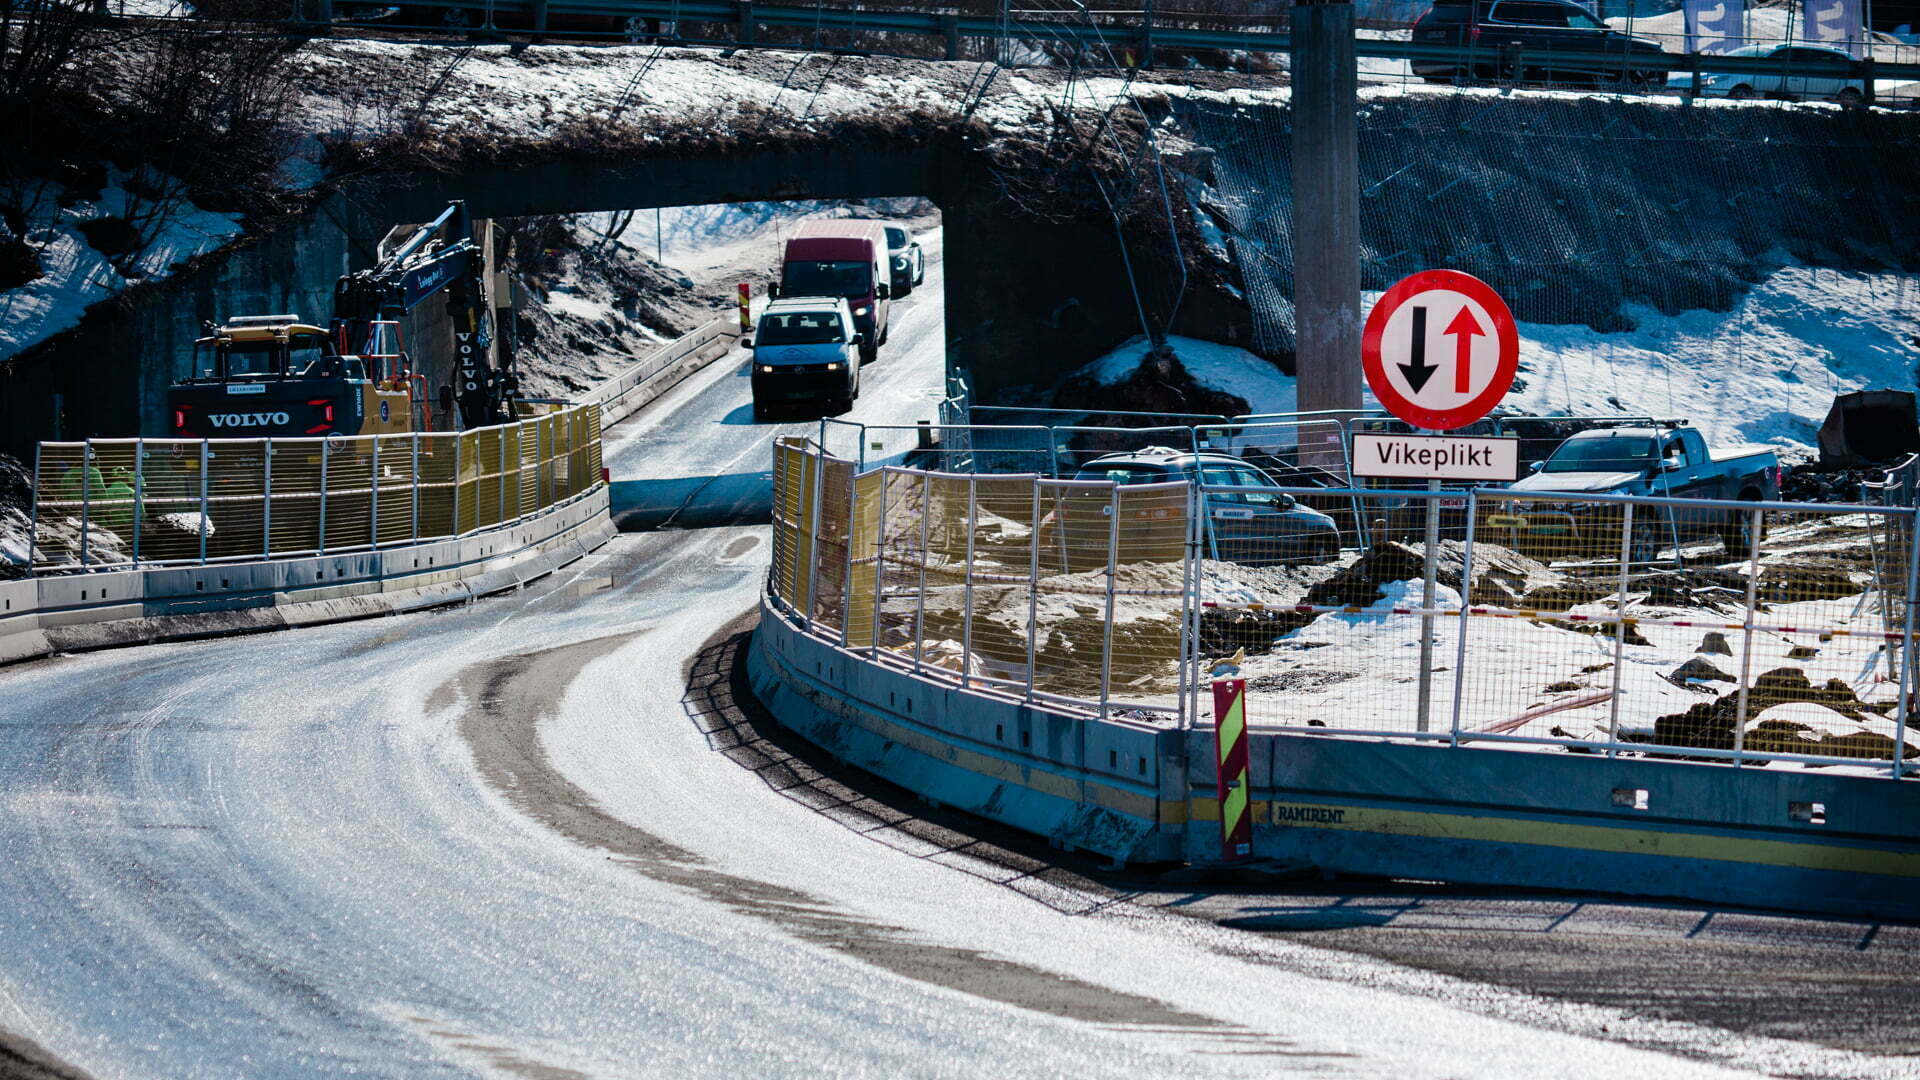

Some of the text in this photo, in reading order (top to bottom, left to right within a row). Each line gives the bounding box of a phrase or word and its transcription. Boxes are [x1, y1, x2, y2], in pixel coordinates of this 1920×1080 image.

[455, 332, 477, 391] VOLVO
[207, 411, 290, 428] VOLVO
[1376, 442, 1492, 471] Vikeplikt
[1278, 805, 1345, 824] RAMIRENT
